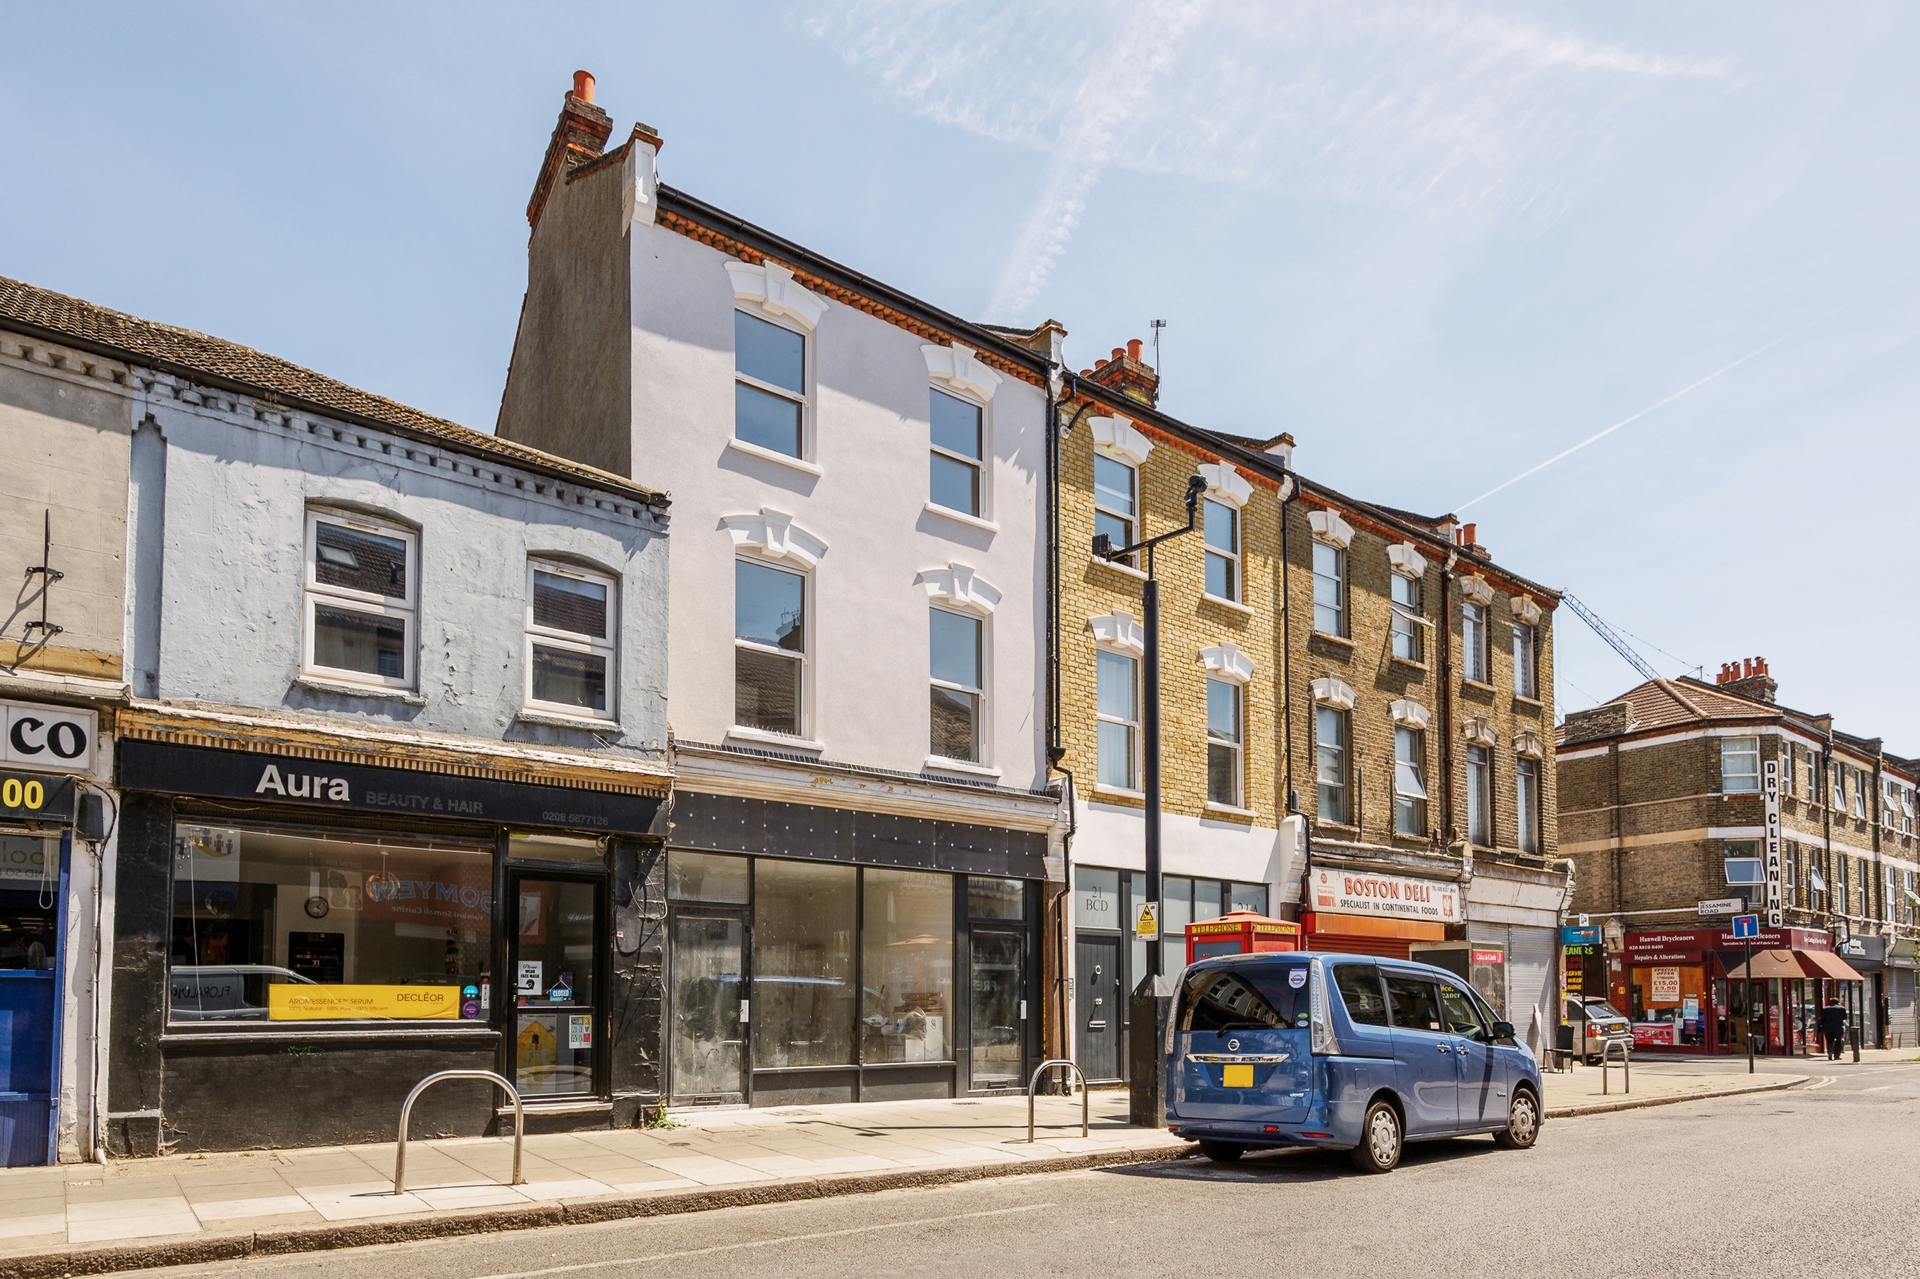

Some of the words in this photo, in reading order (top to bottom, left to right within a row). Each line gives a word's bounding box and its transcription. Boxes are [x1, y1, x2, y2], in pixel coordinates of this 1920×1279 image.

[10, 716, 87, 759] CO
[255, 764, 350, 801] Aura
[1766, 762, 1777, 803] DRY
[365, 790, 429, 809] BEAUTY
[432, 797, 444, 811] &
[447, 798, 484, 815] HAIR
[541, 811, 567, 823] 0208
[1768, 813, 1781, 926] CLEANING
[1091, 886, 1102, 899] 21
[1344, 876, 1400, 900] BOSTON
[1404, 883, 1430, 903] DELI
[1085, 898, 1109, 912] BCD
[1340, 899, 1370, 910] SPECIALIST
[1373, 902, 1380, 911] IN
[1382, 902, 1419, 914] CONTINENTAL
[1421, 905, 1439, 916] FOODS
[1700, 902, 1732, 911] JESSAMINE
[1193, 923, 1239, 933] TELEPHONE
[1259, 924, 1294, 933] TELEPHONE
[1639, 935, 1661, 943] Hanwell
[1661, 934, 1695, 943] Drycleaners
[552, 989, 570, 997] CLOSED
